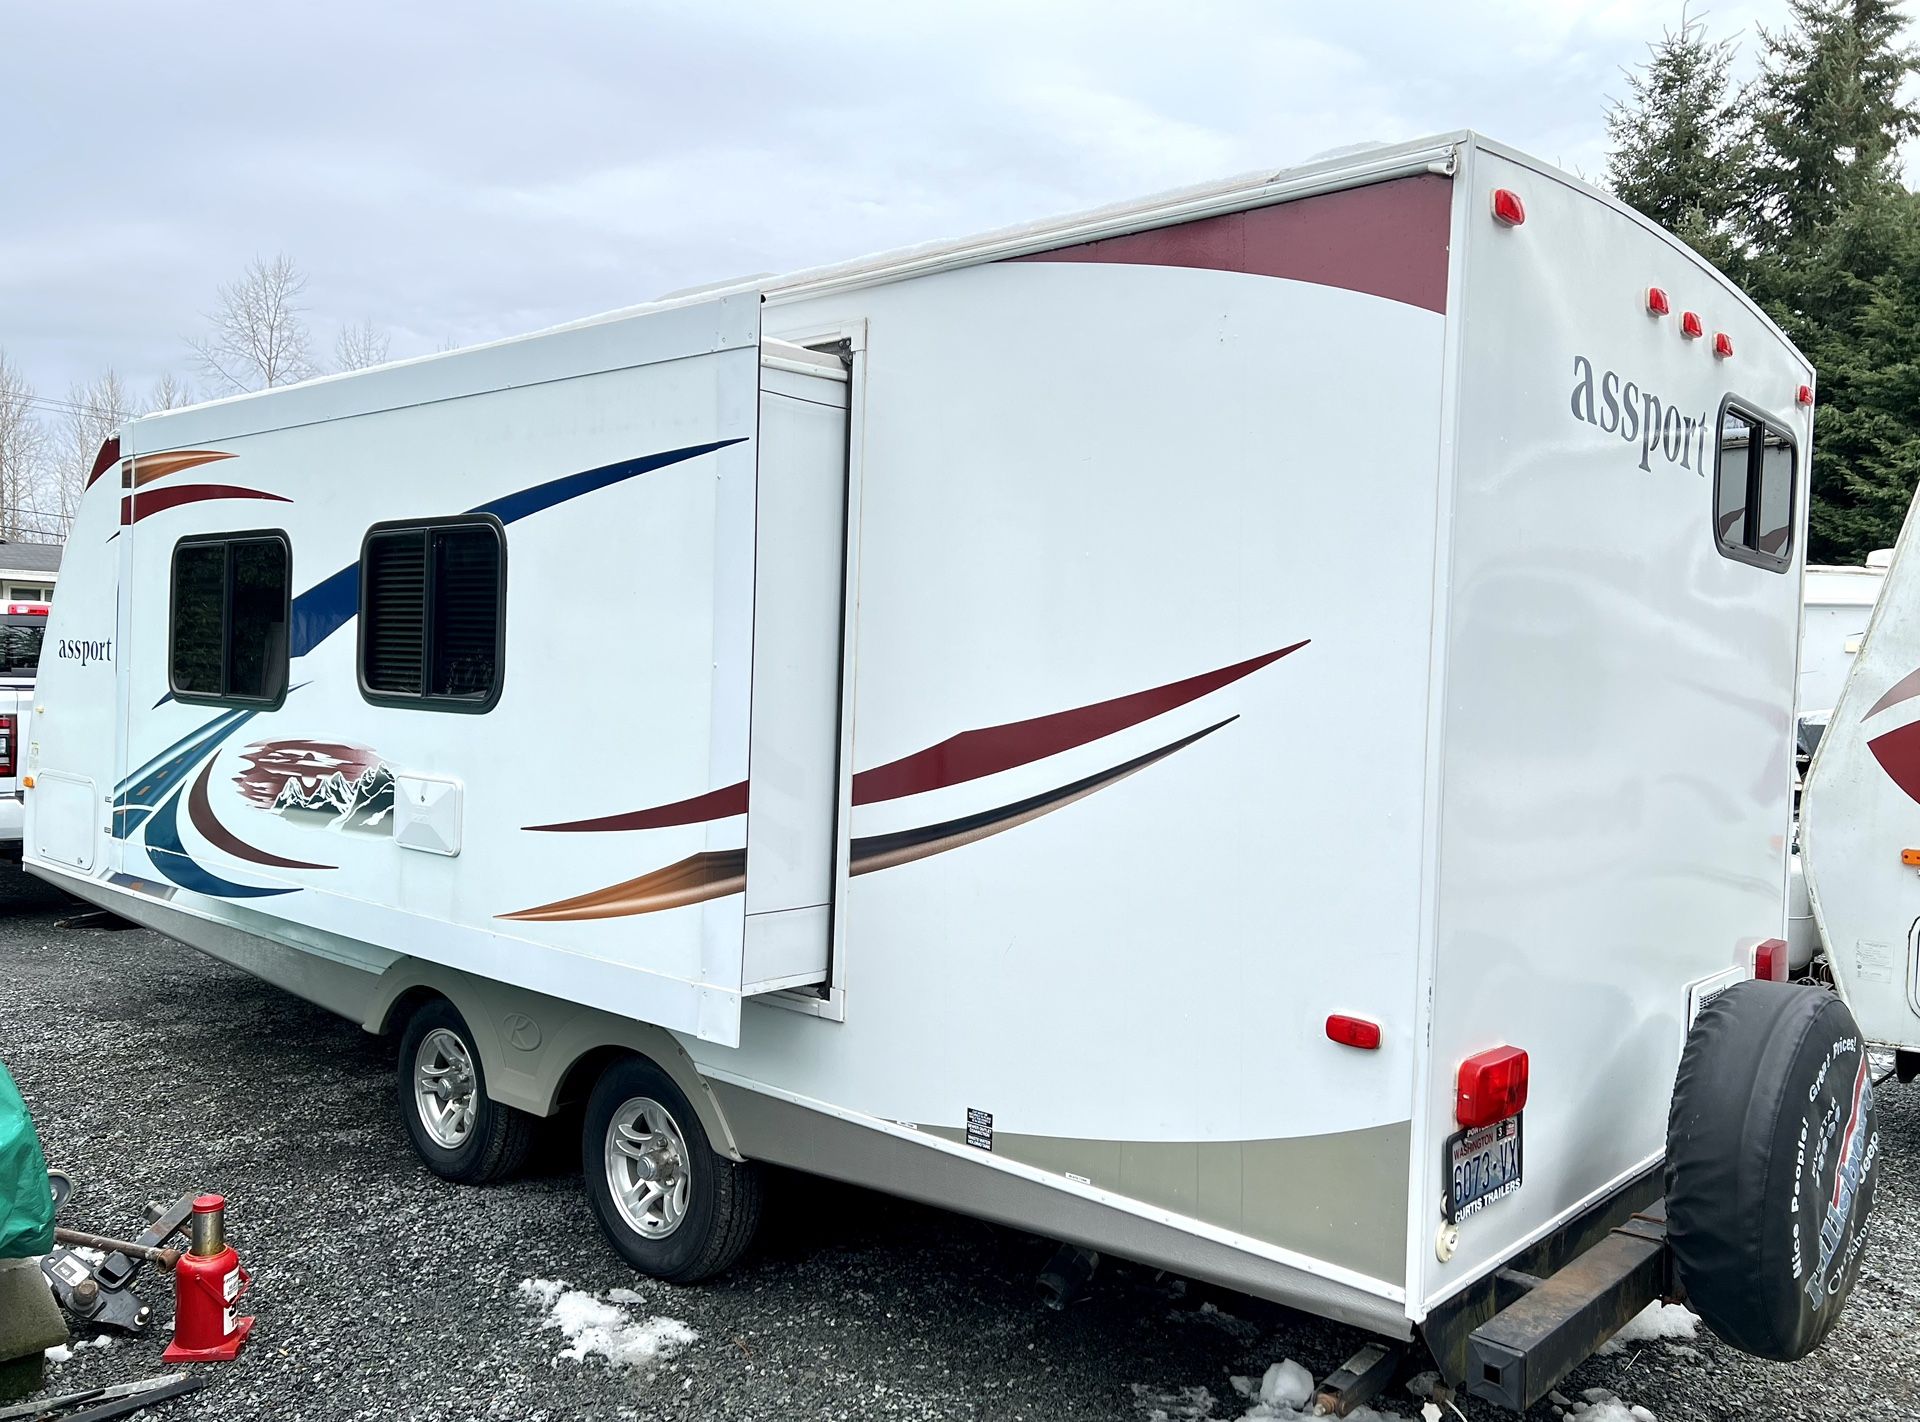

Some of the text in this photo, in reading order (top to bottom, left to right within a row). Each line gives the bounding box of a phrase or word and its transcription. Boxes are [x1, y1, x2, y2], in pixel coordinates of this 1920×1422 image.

[1570, 355, 1708, 478] assport
[59, 637, 112, 666] assport
[1453, 1132, 1494, 1160] WASHINGTON
[1791, 1036, 1857, 1279] Nice People! Great Prices!
[1859, 1131, 1879, 1184] Jeep
[1455, 1177, 1521, 1223] CURTIS TRAILERS
